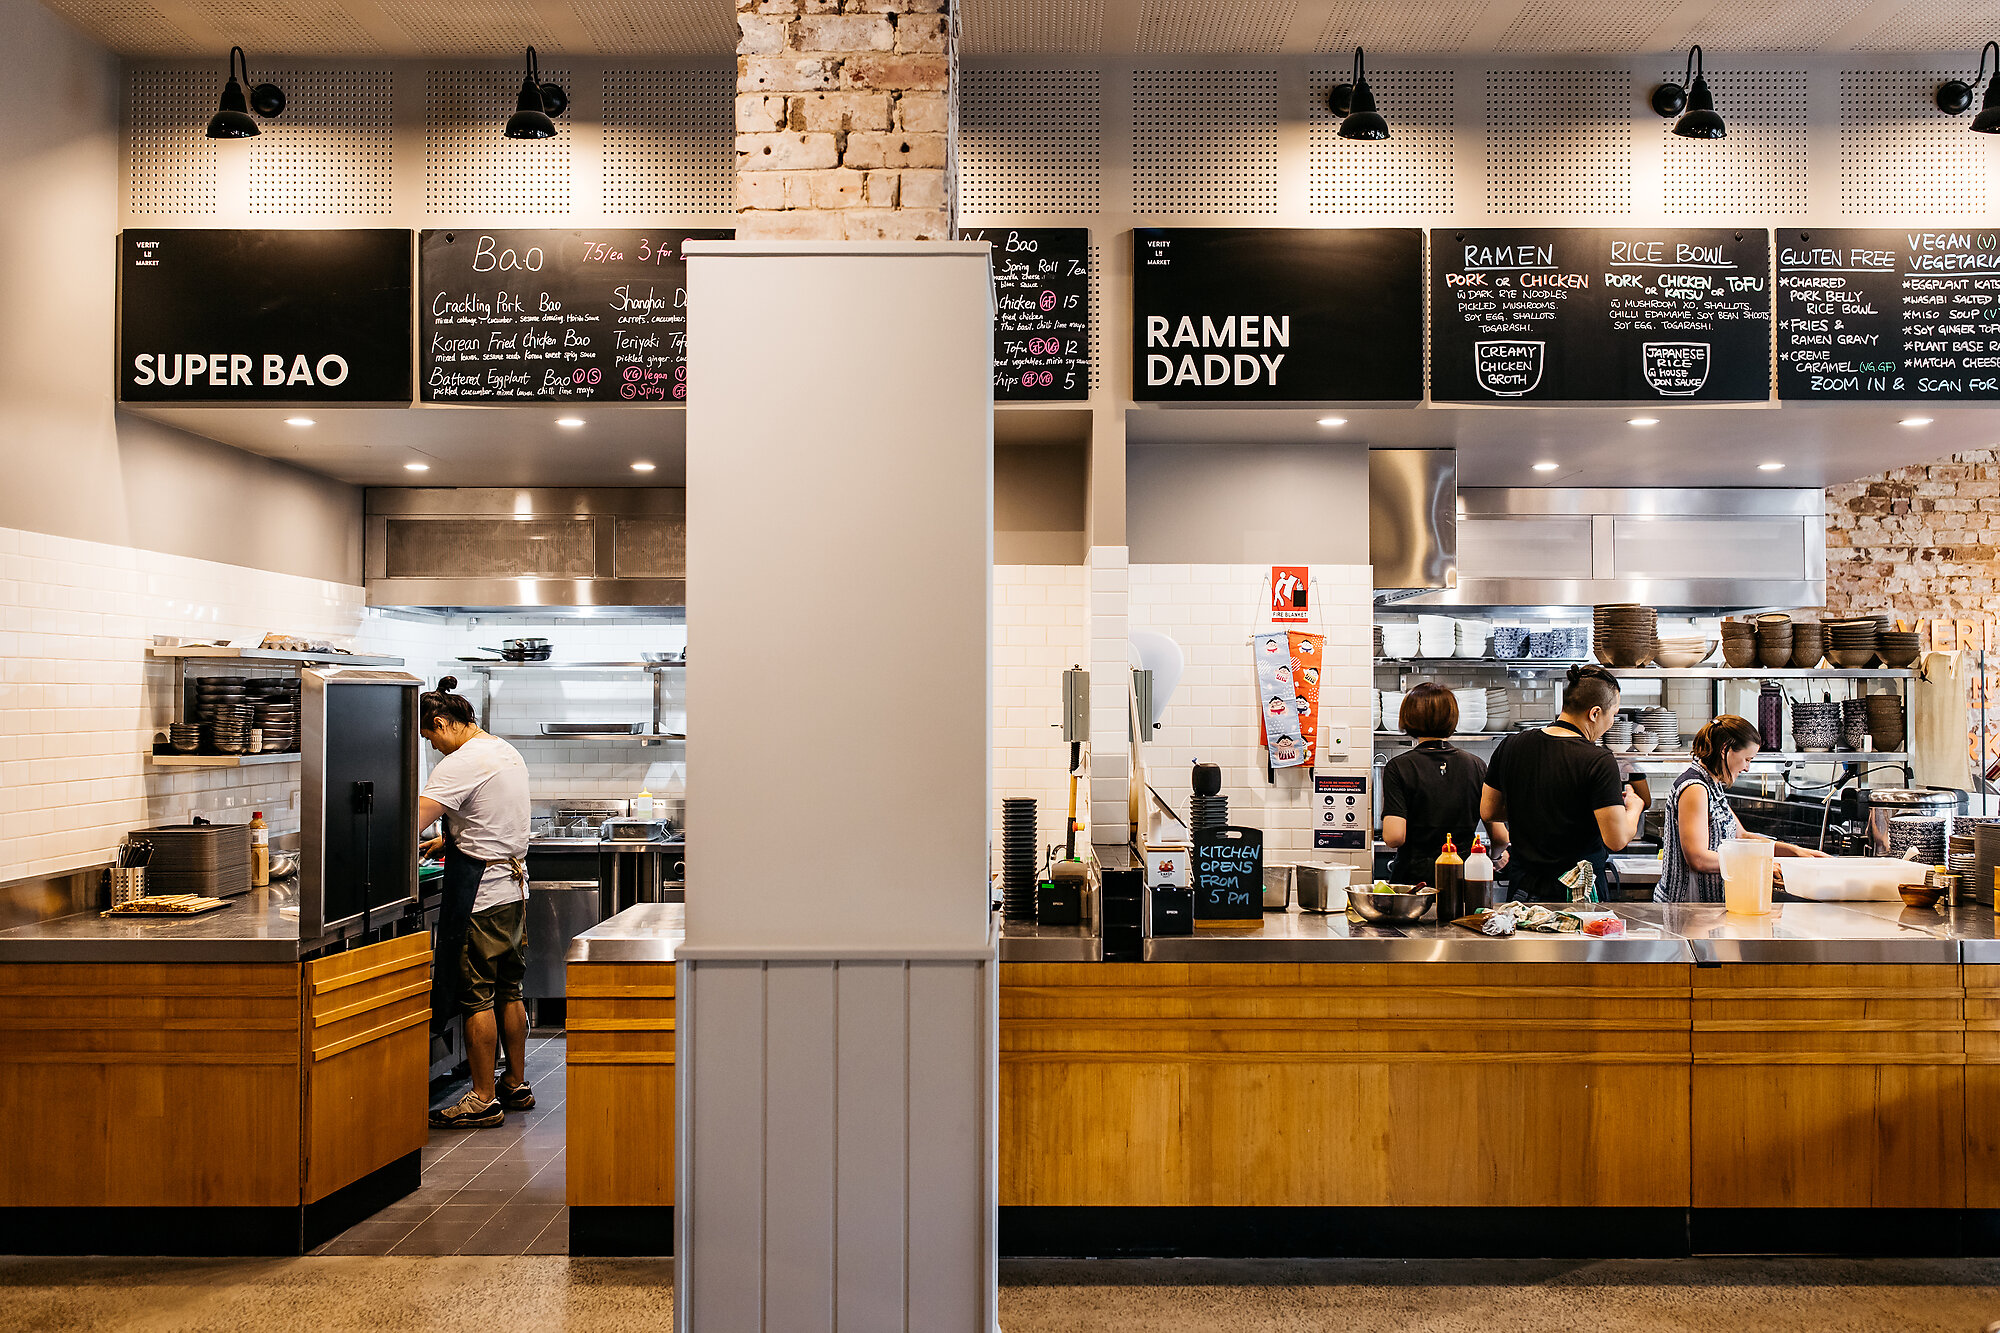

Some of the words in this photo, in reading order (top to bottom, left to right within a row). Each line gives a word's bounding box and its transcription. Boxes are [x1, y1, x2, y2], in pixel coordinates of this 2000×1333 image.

[1005, 230, 1038, 252] Bao
[1907, 232, 1971, 251] VEGAN
[472, 235, 544, 272] Bao
[583, 242, 624, 264] 7.5/ea
[638, 238, 652, 261] 3
[656, 242, 672, 266] for
[1464, 244, 1553, 266] RAMEN
[1611, 240, 1664, 262] RICE
[1676, 244, 1732, 264] BOWL
[1780, 248, 1842, 266] GLUTEN
[1850, 248, 1896, 267] FREE
[1002, 258, 1030, 277] Spring
[1038, 258, 1058, 272] Roll
[1446, 273, 1488, 288] PORK
[1496, 277, 1511, 287] OR
[1520, 273, 1590, 289] CHICKEN
[1604, 273, 1644, 288] PORK
[1658, 274, 1712, 290] CHICKEN
[1725, 276, 1764, 292] TOFU
[1911, 279, 1970, 291] EGGPLANT
[1468, 290, 1494, 300] DARK
[1498, 290, 1518, 299] RYE
[1522, 290, 1568, 300] NOODLES
[1645, 286, 1658, 296] OR
[1664, 288, 1704, 300] KATSU
[1710, 288, 1725, 296] OR
[1790, 289, 1822, 302] PORK
[1825, 290, 1863, 302] BELLY
[1910, 295, 1948, 305] WASABI
[1952, 294, 1992, 306] SALTED
[432, 291, 491, 320] Crackling
[496, 291, 525, 314] Pork
[539, 292, 562, 312] Bao
[609, 284, 666, 317] Shanghai
[999, 294, 1036, 310] Chicken
[1063, 294, 1080, 308] 15
[1458, 302, 1497, 312] PICKLED
[1502, 302, 1559, 310] MUSHROOMS.
[1624, 300, 1677, 309] MUSHROOM
[1609, 310, 1639, 319] CHILLI
[1697, 312, 1714, 320] SOY
[1718, 312, 1740, 320] BEAN
[1743, 311, 1770, 320] SHOOTS
[1806, 302, 1835, 315] RICE
[1842, 302, 1879, 315] BOWL
[1949, 308, 1980, 320] SOUP
[1018, 312, 1044, 320] chicken
[1464, 313, 1482, 322] SOY
[1486, 314, 1508, 322] EGG.
[1512, 312, 1557, 320] SHALLOTS.
[1147, 316, 1290, 348] RAMEN
[1478, 324, 1534, 332] TOGARASHI.
[1614, 322, 1632, 330] SOY
[1661, 321, 1714, 330] TOGARASHI.
[1834, 320, 1845, 330] &
[1938, 324, 1976, 336] GINGER
[1978, 324, 2000, 334] TOF
[432, 331, 480, 354] Korean
[488, 331, 518, 352] Fried
[522, 326, 557, 350] Chicken
[564, 328, 591, 348] Bao
[613, 330, 660, 356] Teriyaki
[1791, 334, 1832, 346] RAMEN
[1837, 334, 1880, 346] GRAVY
[1952, 341, 1984, 352] BASE
[1004, 340, 1028, 358] Tofu
[1064, 340, 1078, 356] 12
[1480, 346, 1537, 358] CREAMY
[1646, 348, 1706, 360] JAPANESE
[615, 354, 644, 368] pickled
[1480, 360, 1532, 372] CHICKEN
[1657, 359, 1692, 368] RICE
[1796, 360, 1859, 374] CARAMEL
[1914, 357, 1956, 369] MATCHA
[134, 354, 253, 386] SUPER
[263, 354, 349, 386] BAO
[644, 368, 668, 386] Vegan
[1147, 354, 1286, 386] DADDY
[1659, 368, 1689, 378] HOUSE
[428, 366, 481, 386] Battered
[488, 368, 531, 389] Eggplant
[544, 368, 570, 386] Bao
[1064, 372, 1076, 390] 5
[1488, 374, 1527, 385] BROTH
[1654, 378, 1673, 387] DON
[1674, 378, 1702, 387] SAUCE
[1810, 376, 1860, 391] ZOOM
[1868, 376, 1886, 392] IN
[1892, 376, 1906, 392] &
[1918, 377, 1962, 392] SCAN
[1968, 378, 1999, 392] FOR
[638, 384, 664, 400] Spicy
[1200, 844, 1260, 860] KITCHEN
[1200, 860, 1253, 874] OPENS
[1200, 874, 1240, 888] FROM
[1210, 889, 1226, 904] 5
[1228, 892, 1249, 904] PM
